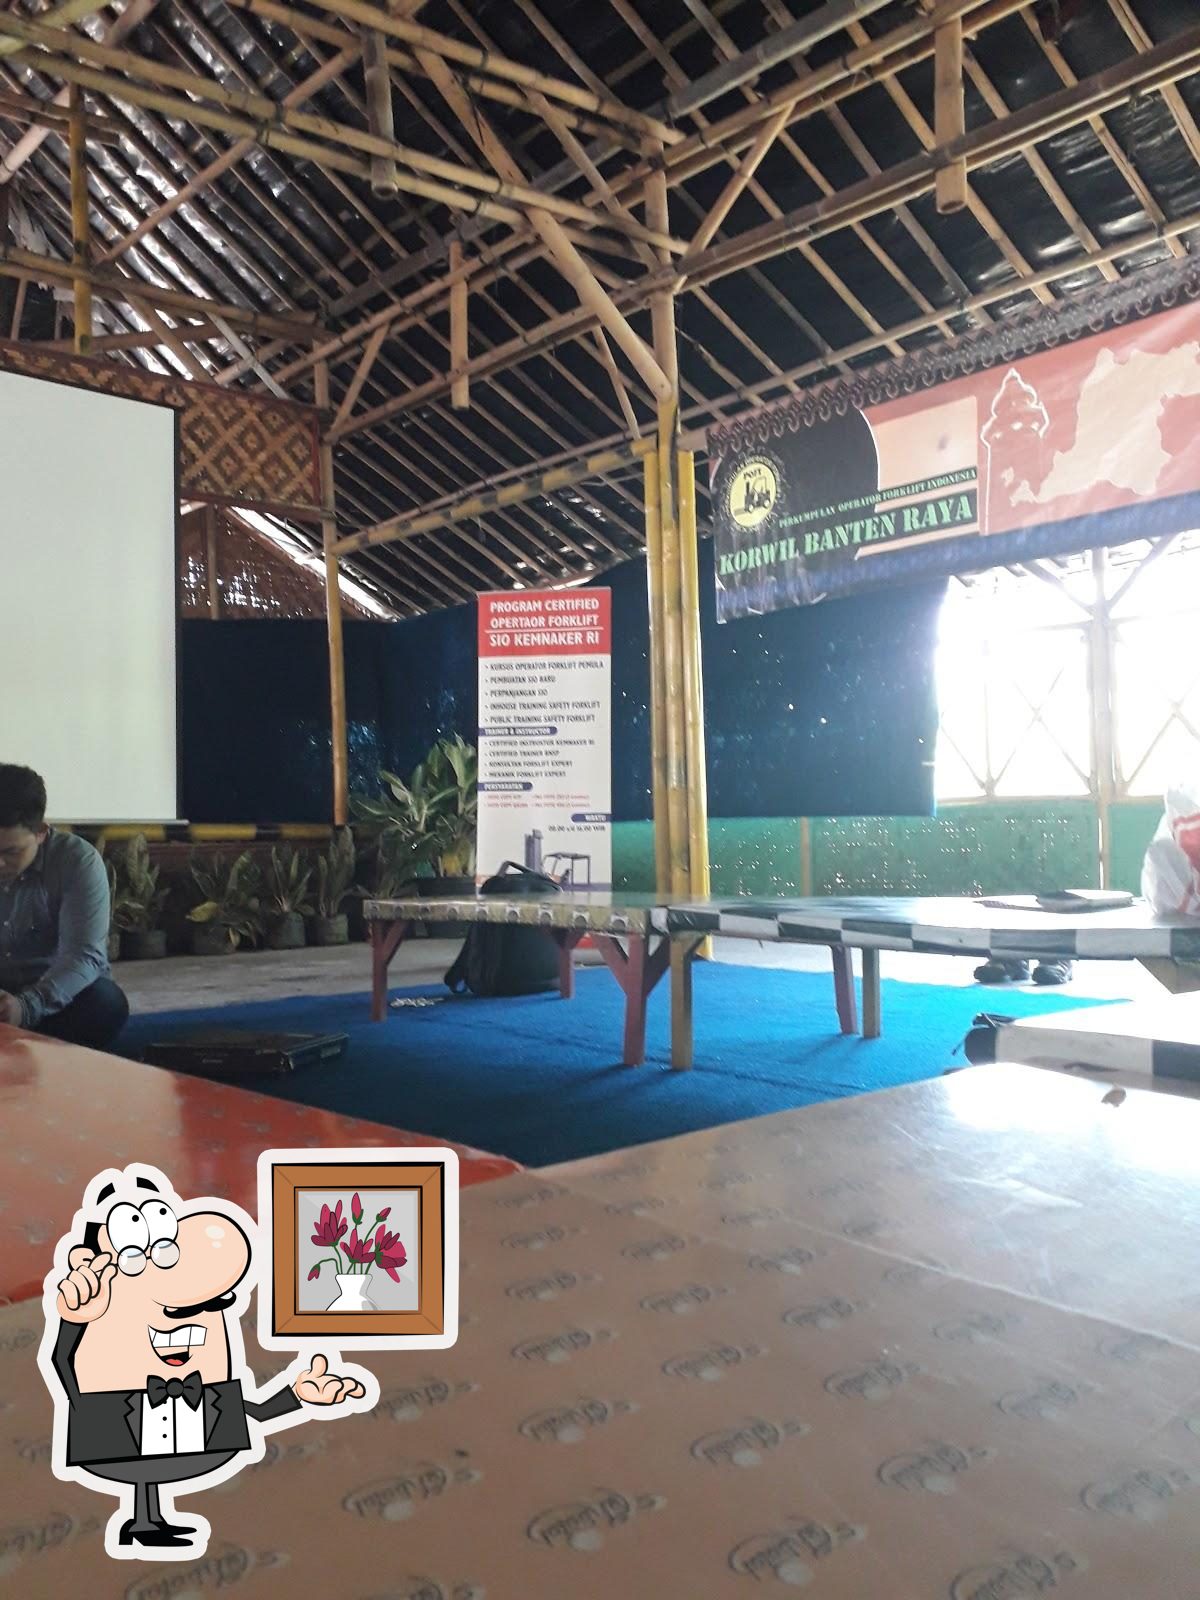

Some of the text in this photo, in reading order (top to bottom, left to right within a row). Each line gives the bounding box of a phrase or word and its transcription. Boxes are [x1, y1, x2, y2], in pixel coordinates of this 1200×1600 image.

[838, 493, 881, 512] OPERATOR
[883, 483, 925, 501] FORKLIFT
[927, 469, 977, 491] INDONESIA
[719, 495, 973, 575] KORWIL BANTEN RAYA
[490, 598, 599, 613] PROGRAM CERTIFIED
[490, 615, 599, 629] OPERTAOR FORKLIFT
[489, 631, 599, 647] SIO KEMNAKER RI
[490, 661, 604, 671] KURSUS OPERATOR FORKLIFT PEMULA
[490, 676, 527, 684] PEMBUATAN
[490, 689, 536, 698] PERPANJANGAN
[490, 701, 600, 710] INHOUSE TRAINING SAFETY FORKLIFT
[490, 716, 512, 724] PUBLIC
[544, 715, 565, 723] SAFETY
[567, 714, 595, 722] FORKLIFT
